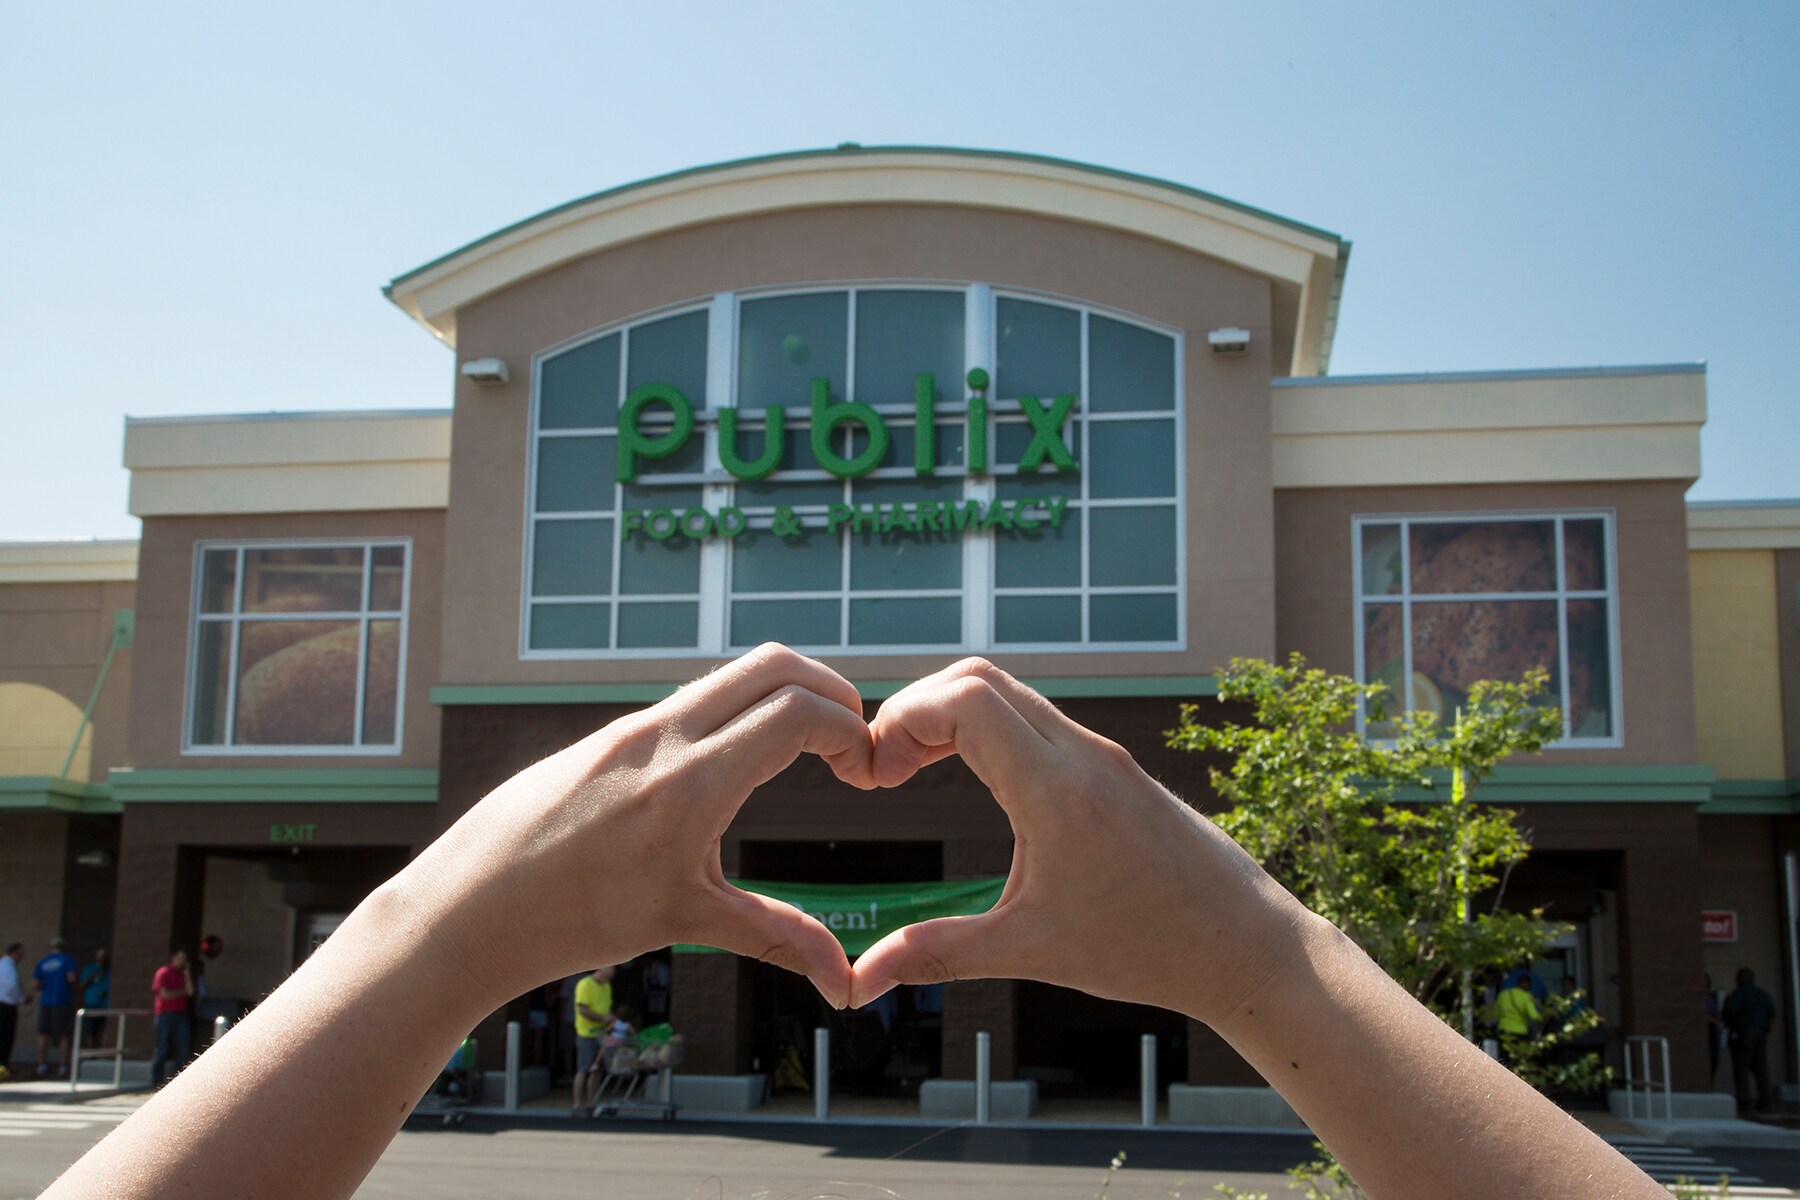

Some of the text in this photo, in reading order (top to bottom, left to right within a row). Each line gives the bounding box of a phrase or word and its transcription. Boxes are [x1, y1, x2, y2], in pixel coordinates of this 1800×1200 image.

[617, 368, 1078, 484] Publix
[621, 496, 1068, 540] FOOD & PHARMACY
[271, 823, 318, 842] EXIT
[788, 901, 878, 930] en!
